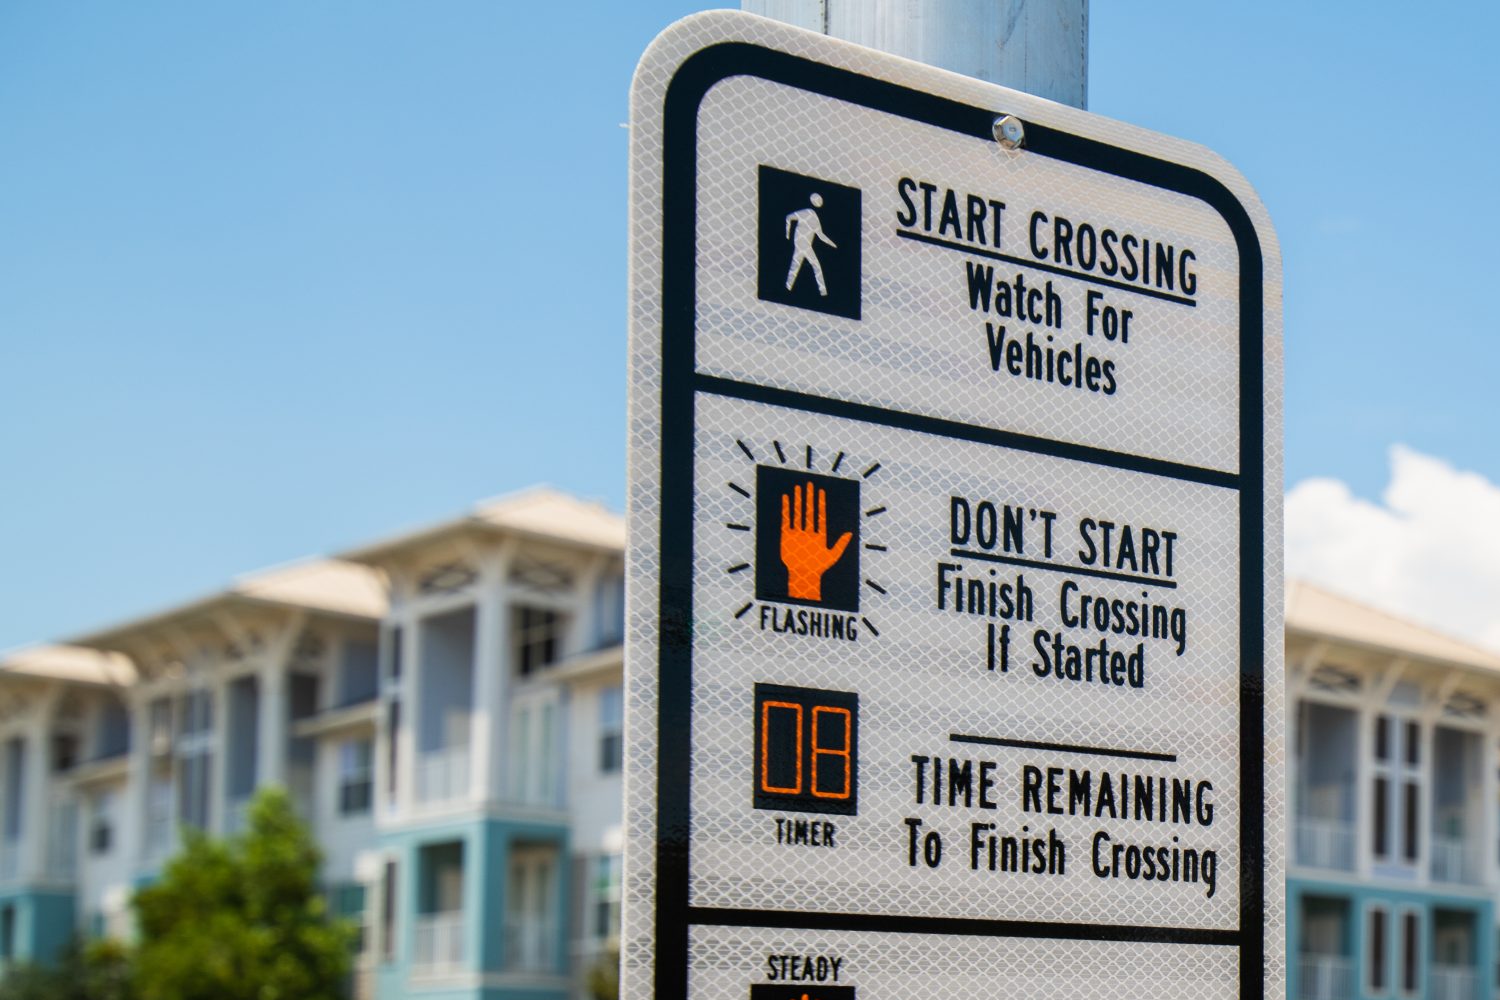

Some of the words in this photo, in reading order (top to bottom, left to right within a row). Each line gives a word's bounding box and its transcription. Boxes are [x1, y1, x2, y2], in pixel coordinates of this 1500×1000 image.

[896, 177, 1006, 248] START
[1029, 211, 1198, 295] CROSSING
[966, 260, 1062, 329] Watch
[1087, 291, 1133, 344] For
[986, 321, 1117, 396] Vehicles
[951, 496, 1056, 559] DON'T
[1079, 517, 1178, 577] START
[760, 606, 858, 641] FLASHING
[937, 562, 1033, 622] Finish
[1060, 581, 1187, 655] Crossing
[987, 624, 1010, 672] If
[1032, 630, 1145, 688] Started
[911, 755, 998, 810] TIME
[1023, 766, 1214, 827] REMAINING
[775, 818, 835, 848] TIMER
[905, 818, 942, 868] To
[971, 822, 1065, 876] Finish
[1092, 830, 1217, 898] Crossing
[767, 955, 842, 982] STEADY
